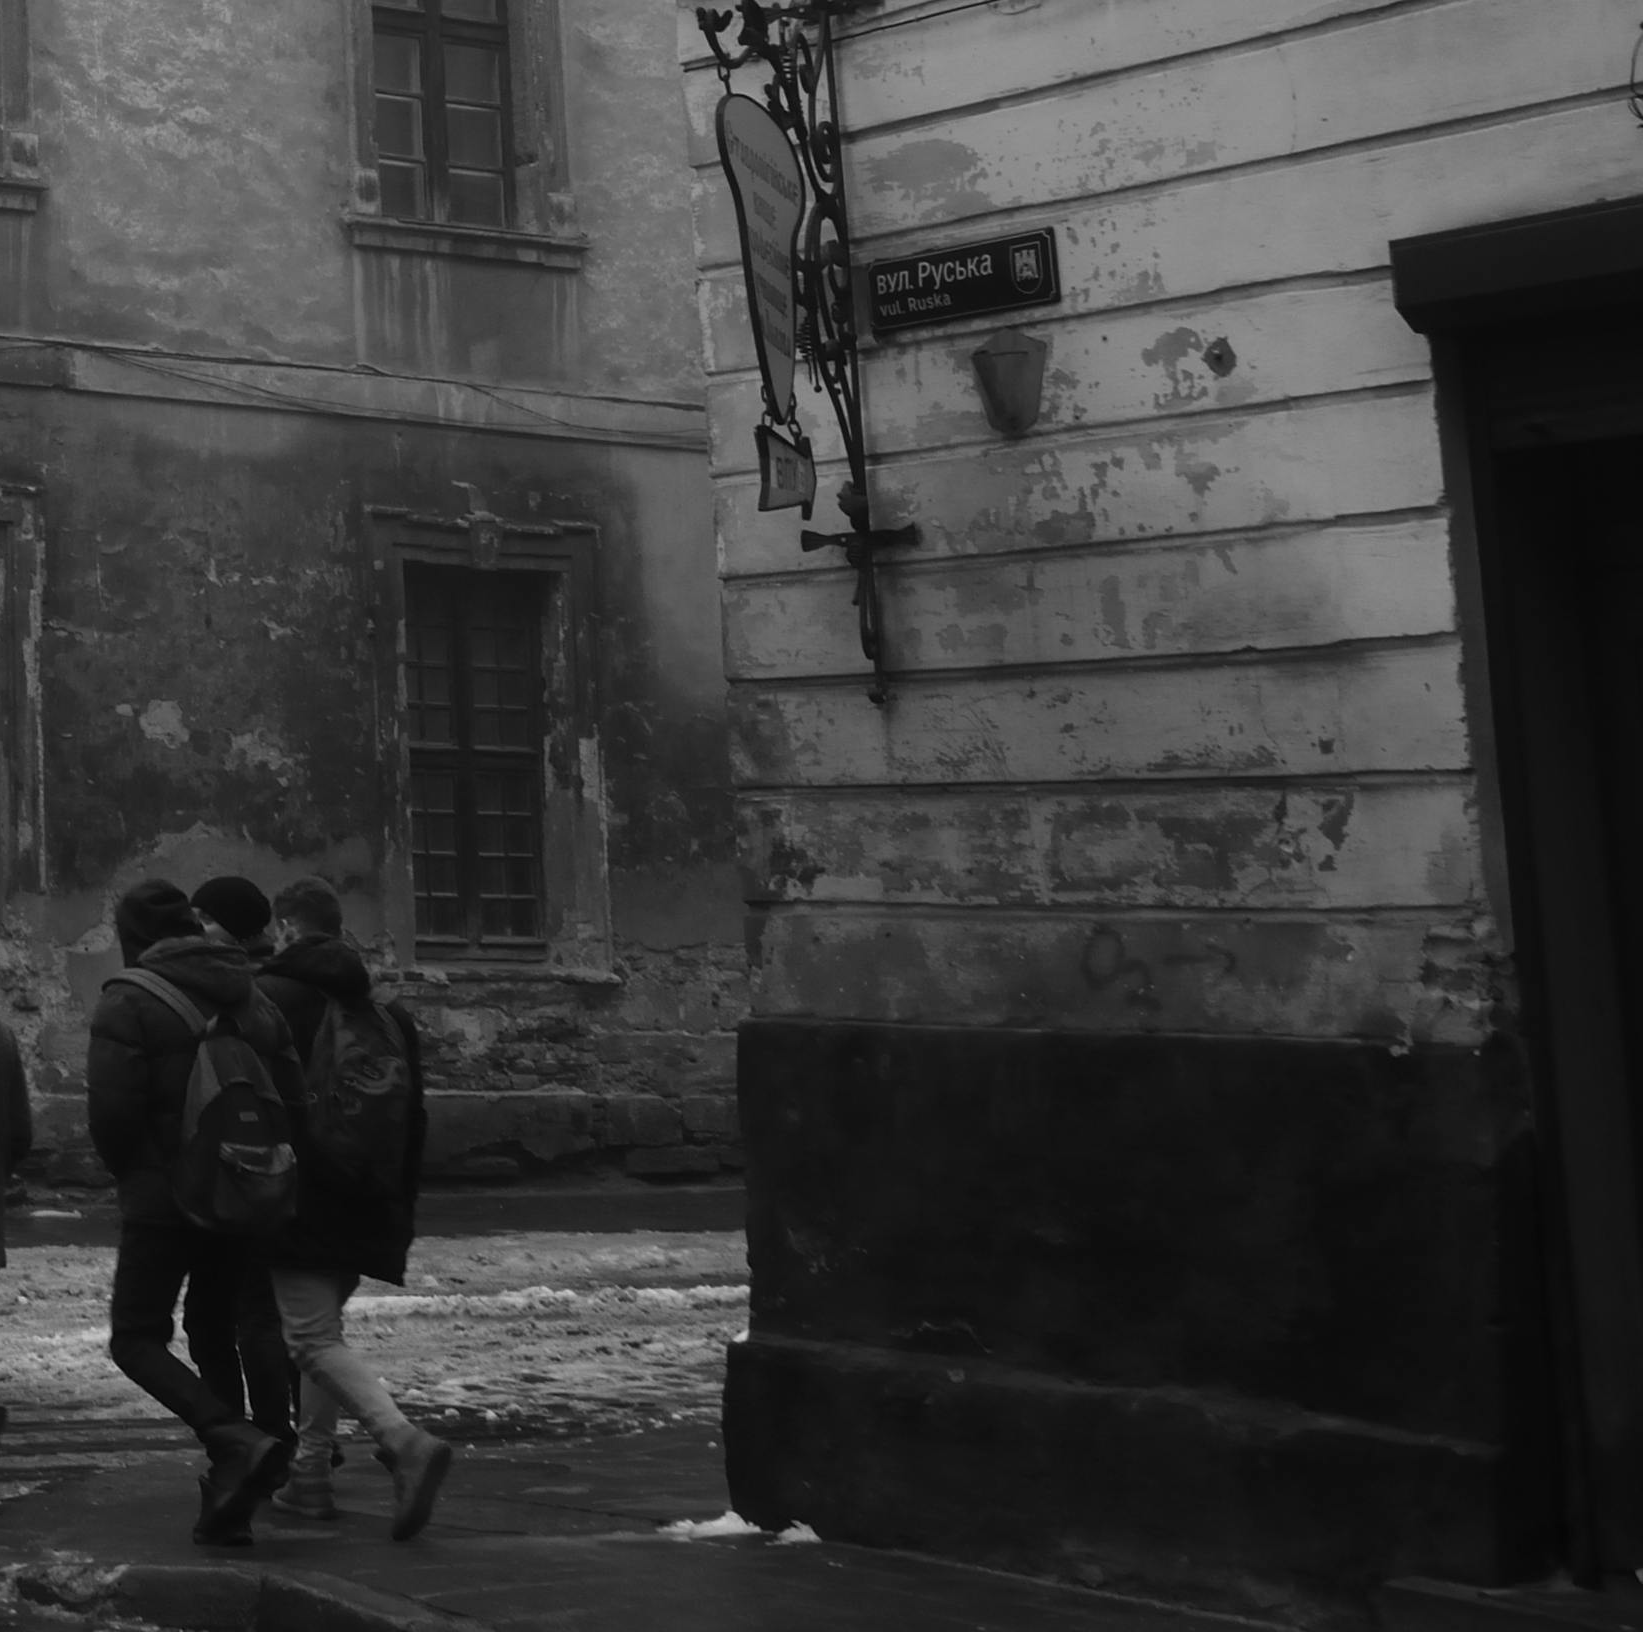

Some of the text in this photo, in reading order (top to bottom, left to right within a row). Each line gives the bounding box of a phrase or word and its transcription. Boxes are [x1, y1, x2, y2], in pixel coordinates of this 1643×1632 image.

[876, 254, 993, 295] вул. Руська
[879, 292, 952, 317] vul. Ruska
